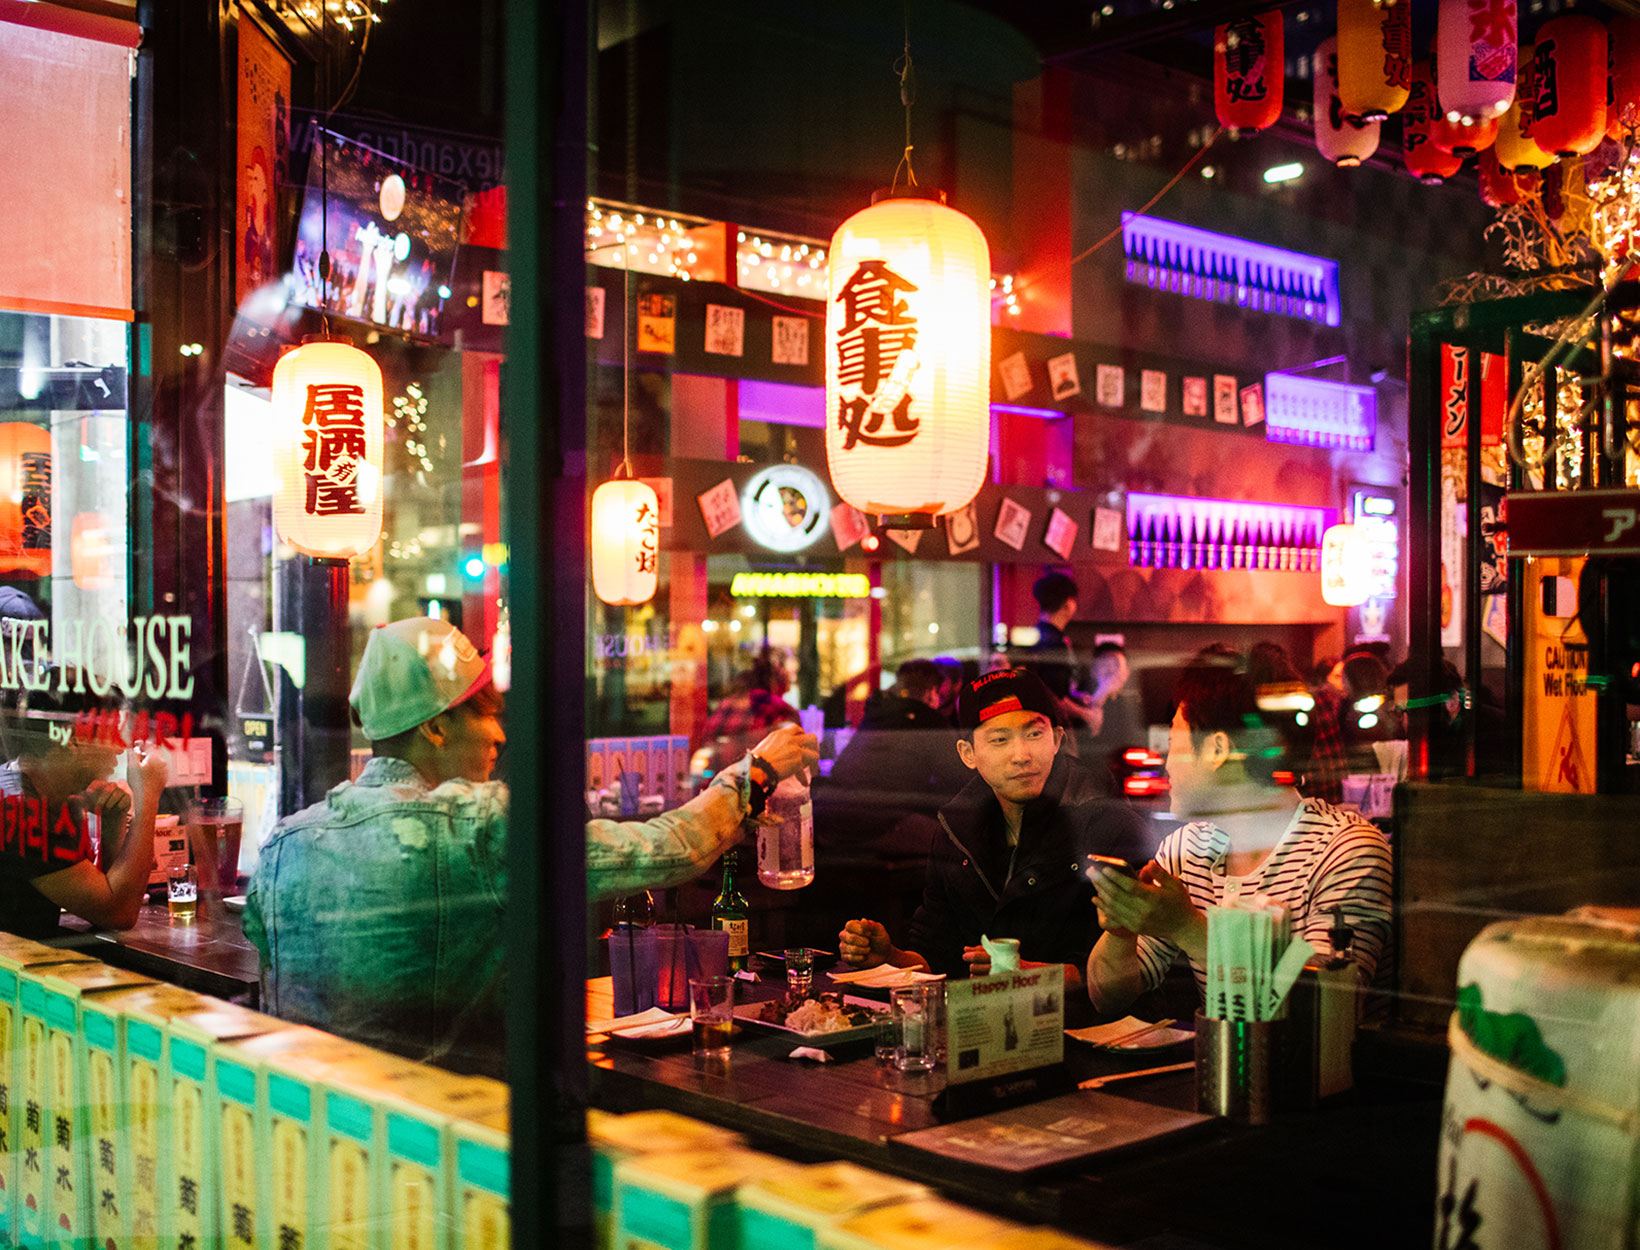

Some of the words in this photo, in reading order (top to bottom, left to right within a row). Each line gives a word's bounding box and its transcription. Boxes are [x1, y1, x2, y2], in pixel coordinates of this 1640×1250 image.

[835, 259, 920, 451] 食事処
[58, 615, 195, 699] HOUSE
[1545, 647, 1586, 670] CAUTION
[1543, 673, 1562, 696] Wet
[50, 721, 72, 746] by
[972, 980, 1010, 996] Happy
[1011, 974, 1041, 990] Hour
